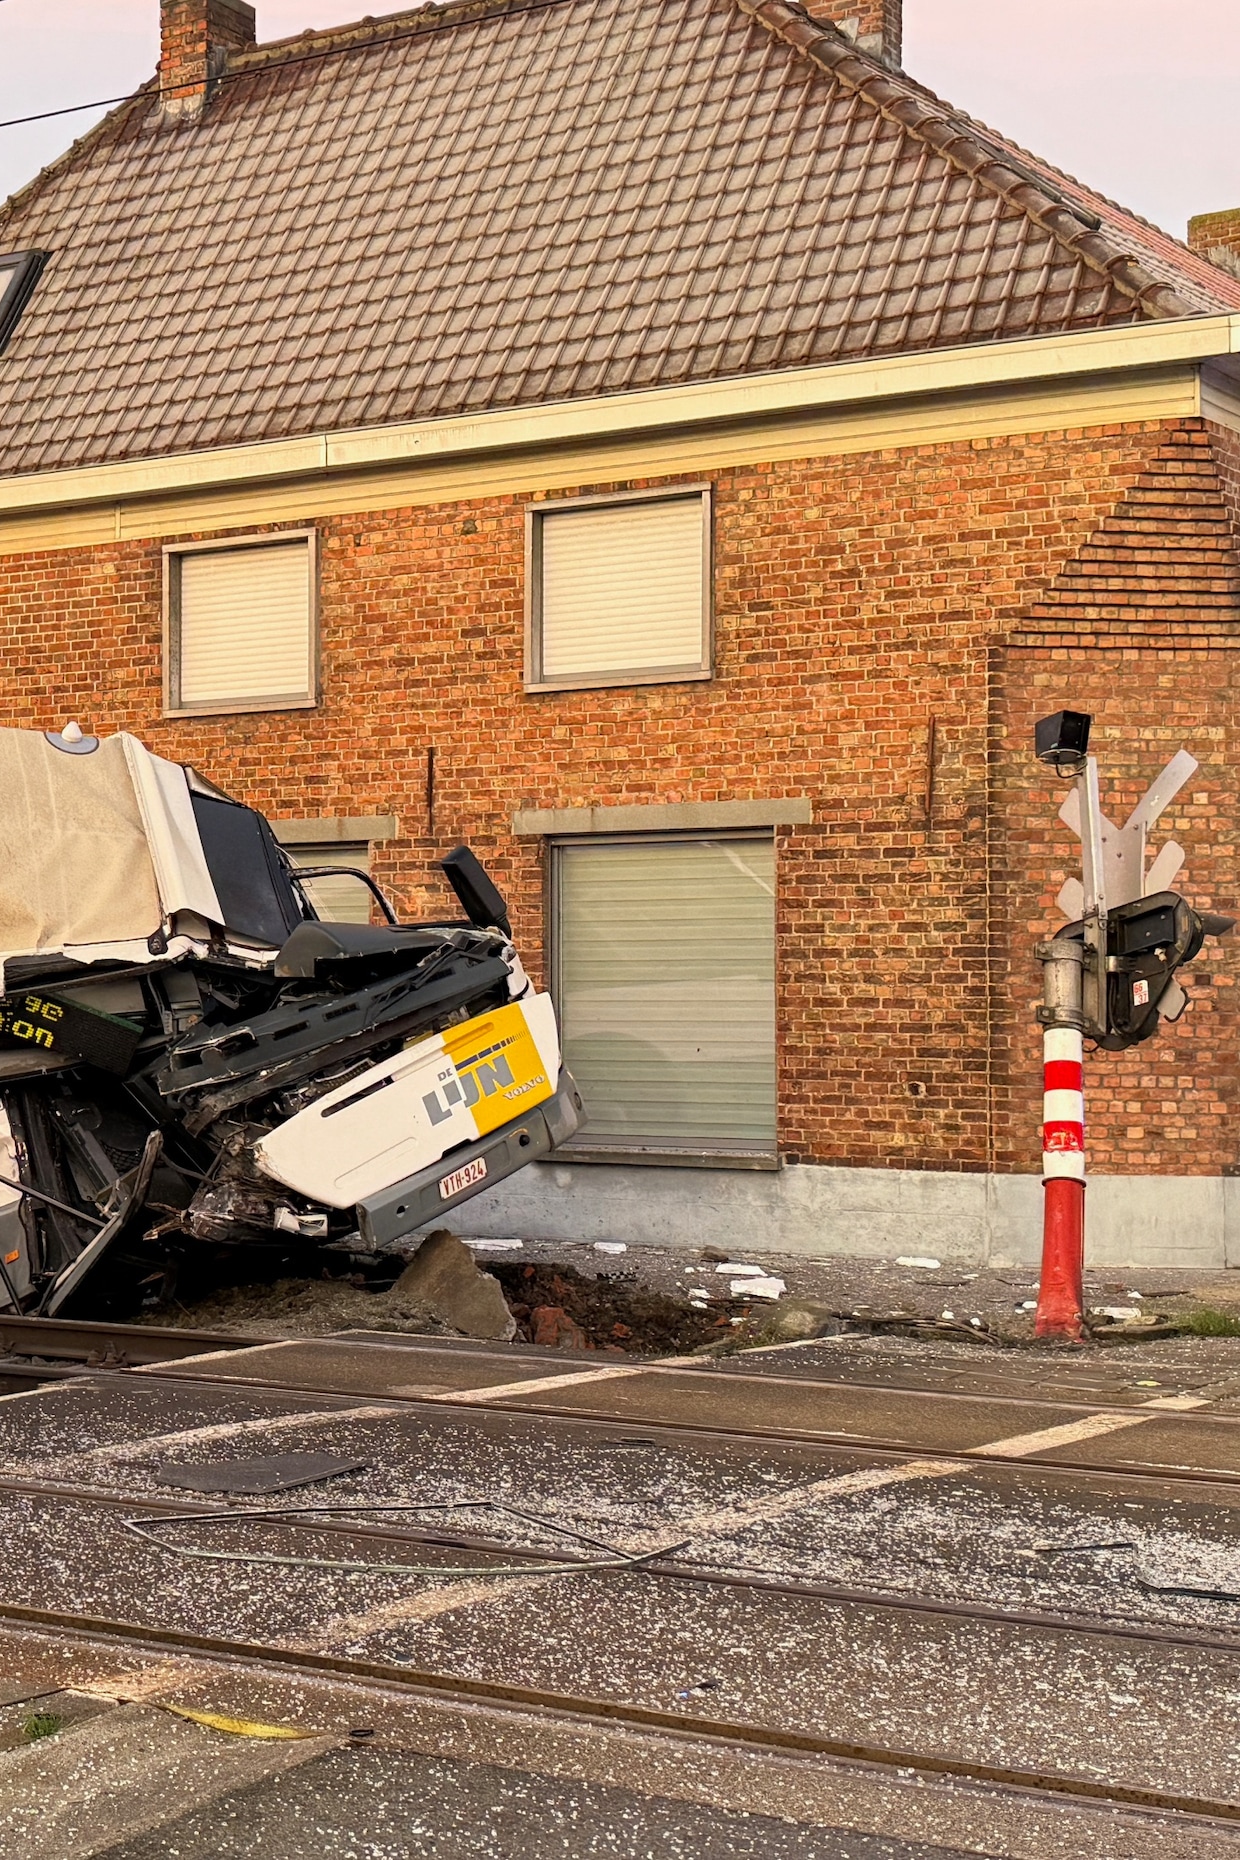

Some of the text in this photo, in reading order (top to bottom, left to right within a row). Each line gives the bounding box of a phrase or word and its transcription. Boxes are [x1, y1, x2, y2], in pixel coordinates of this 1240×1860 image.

[437, 1067, 453, 1082] DE
[502, 1074, 546, 1101] VOLVO
[422, 1053, 516, 1127] LIJN
